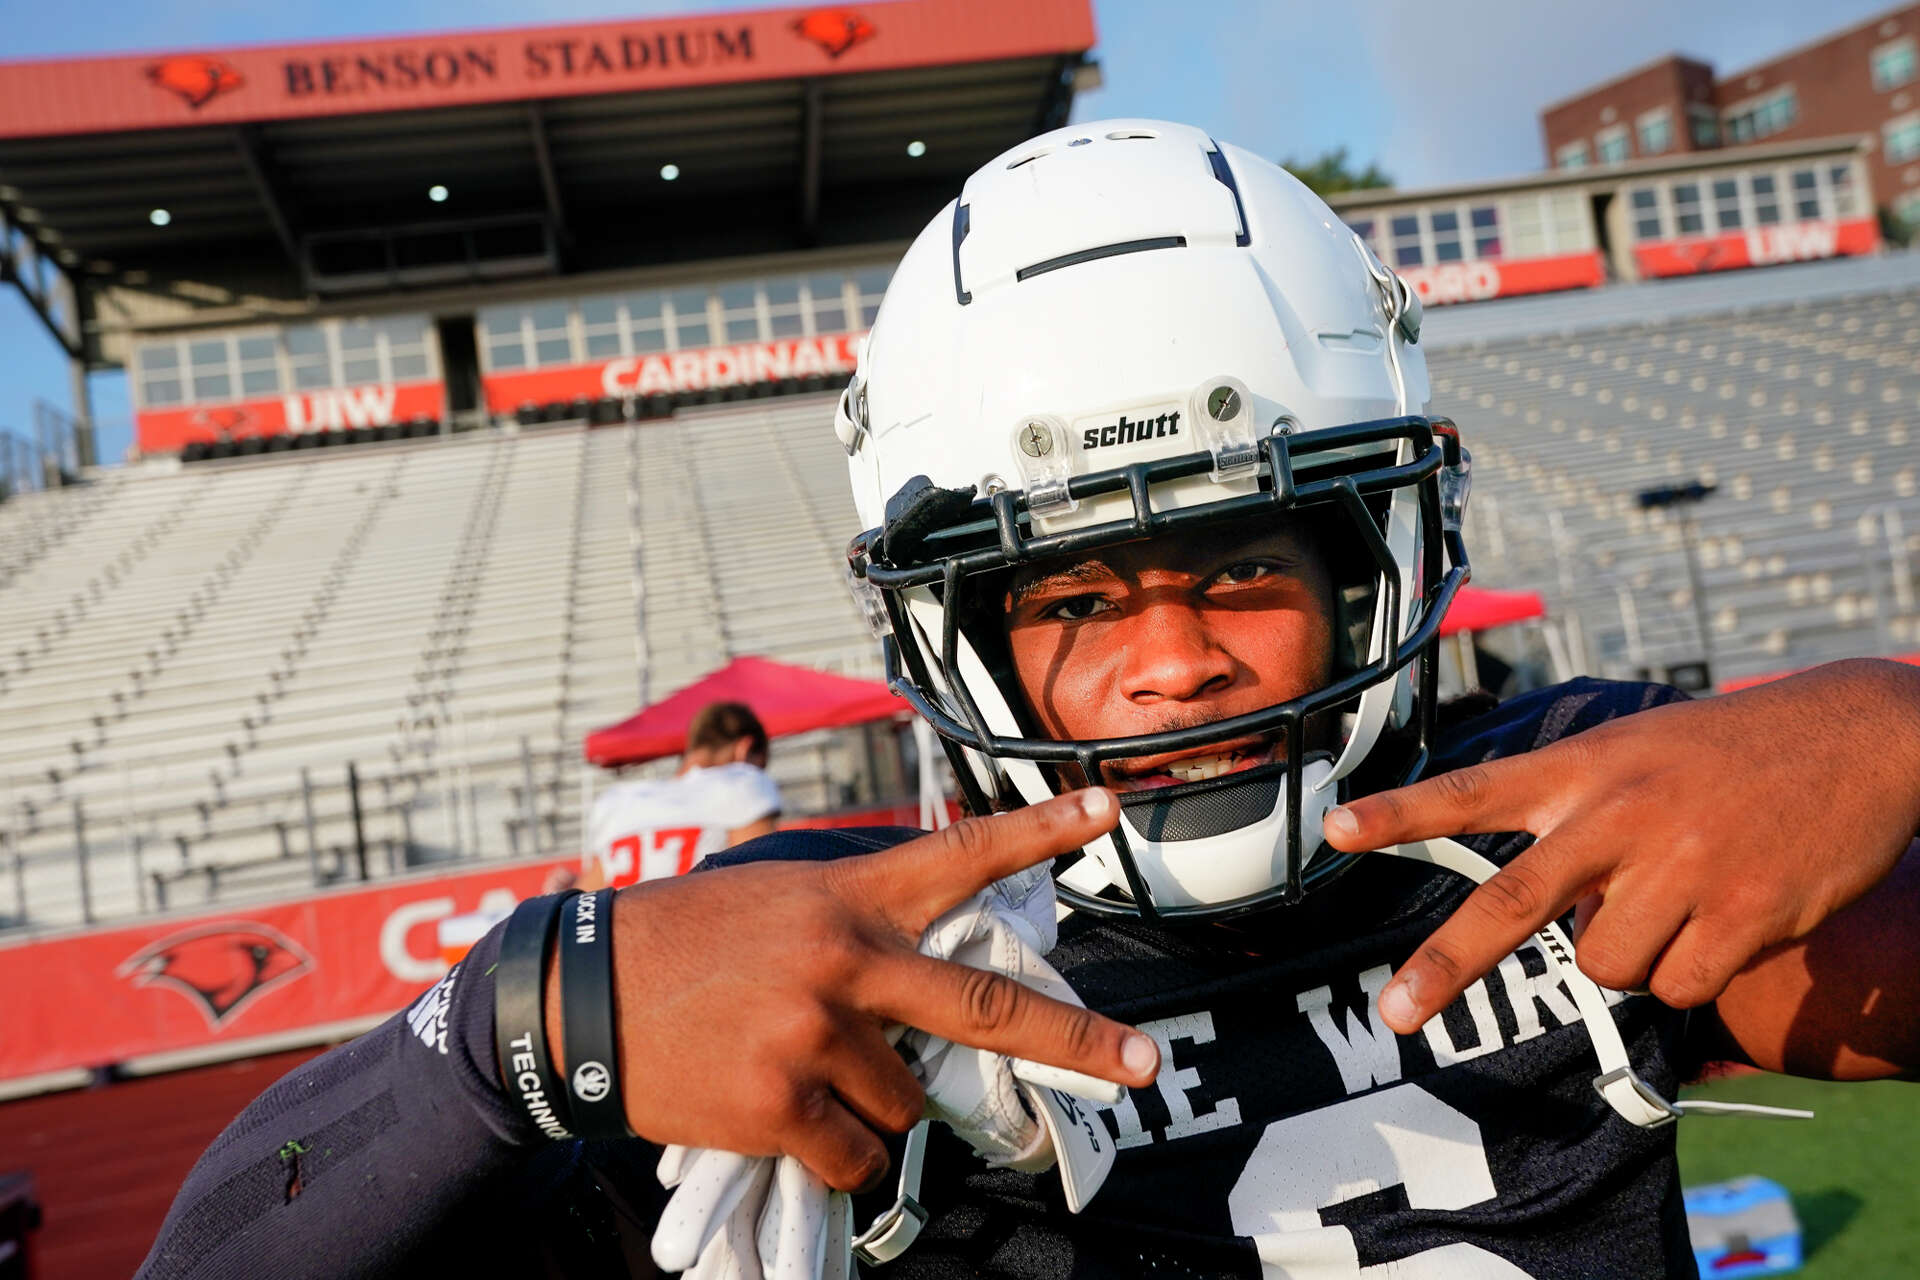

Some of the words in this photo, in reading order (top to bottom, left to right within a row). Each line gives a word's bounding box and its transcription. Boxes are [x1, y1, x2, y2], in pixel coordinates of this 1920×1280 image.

[284, 44, 497, 97] BENSON
[526, 26, 755, 79] STADIUM
[1746, 222, 1836, 265] UIW
[1400, 261, 1501, 305] ORD
[284, 386, 397, 435] UIW
[1083, 410, 1181, 450] schutt
[575, 924, 596, 944] IN
[1540, 927, 1573, 966] utt
[1297, 924, 1624, 1095] WOR
[510, 1031, 574, 1140] TECHNIQ
